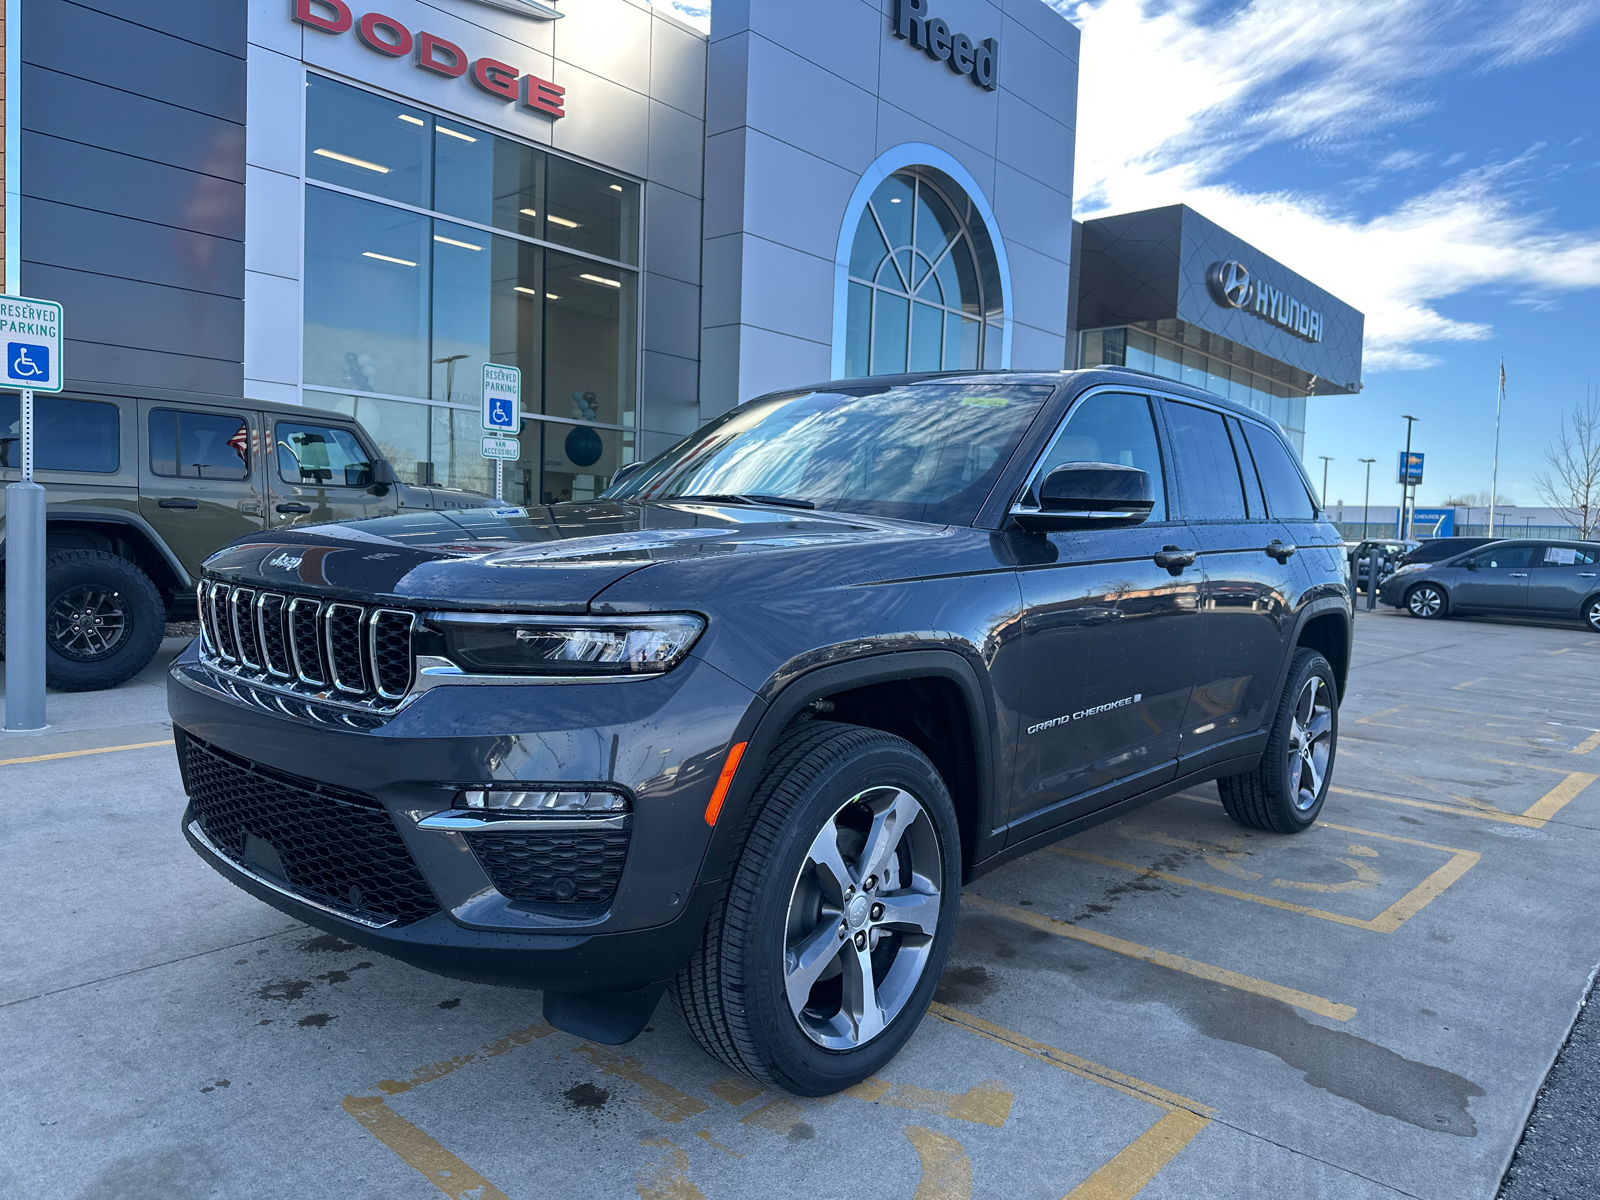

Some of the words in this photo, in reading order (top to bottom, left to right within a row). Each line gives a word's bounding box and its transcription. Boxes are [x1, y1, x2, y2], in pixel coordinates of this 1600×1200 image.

[894, 0, 998, 92] Reed
[292, 0, 565, 119] DODGE
[0, 304, 55, 322] RESERVED
[1254, 279, 1323, 342] HYUNDAI
[0, 320, 56, 337] PARKING
[485, 369, 517, 382] RESERVED
[485, 381, 517, 394] PARKING
[484, 447, 516, 457] ACCESSIBLE
[269, 552, 303, 571] Jeep
[1026, 714, 1070, 735] GRAND
[1072, 696, 1133, 720] CHEROKEE
